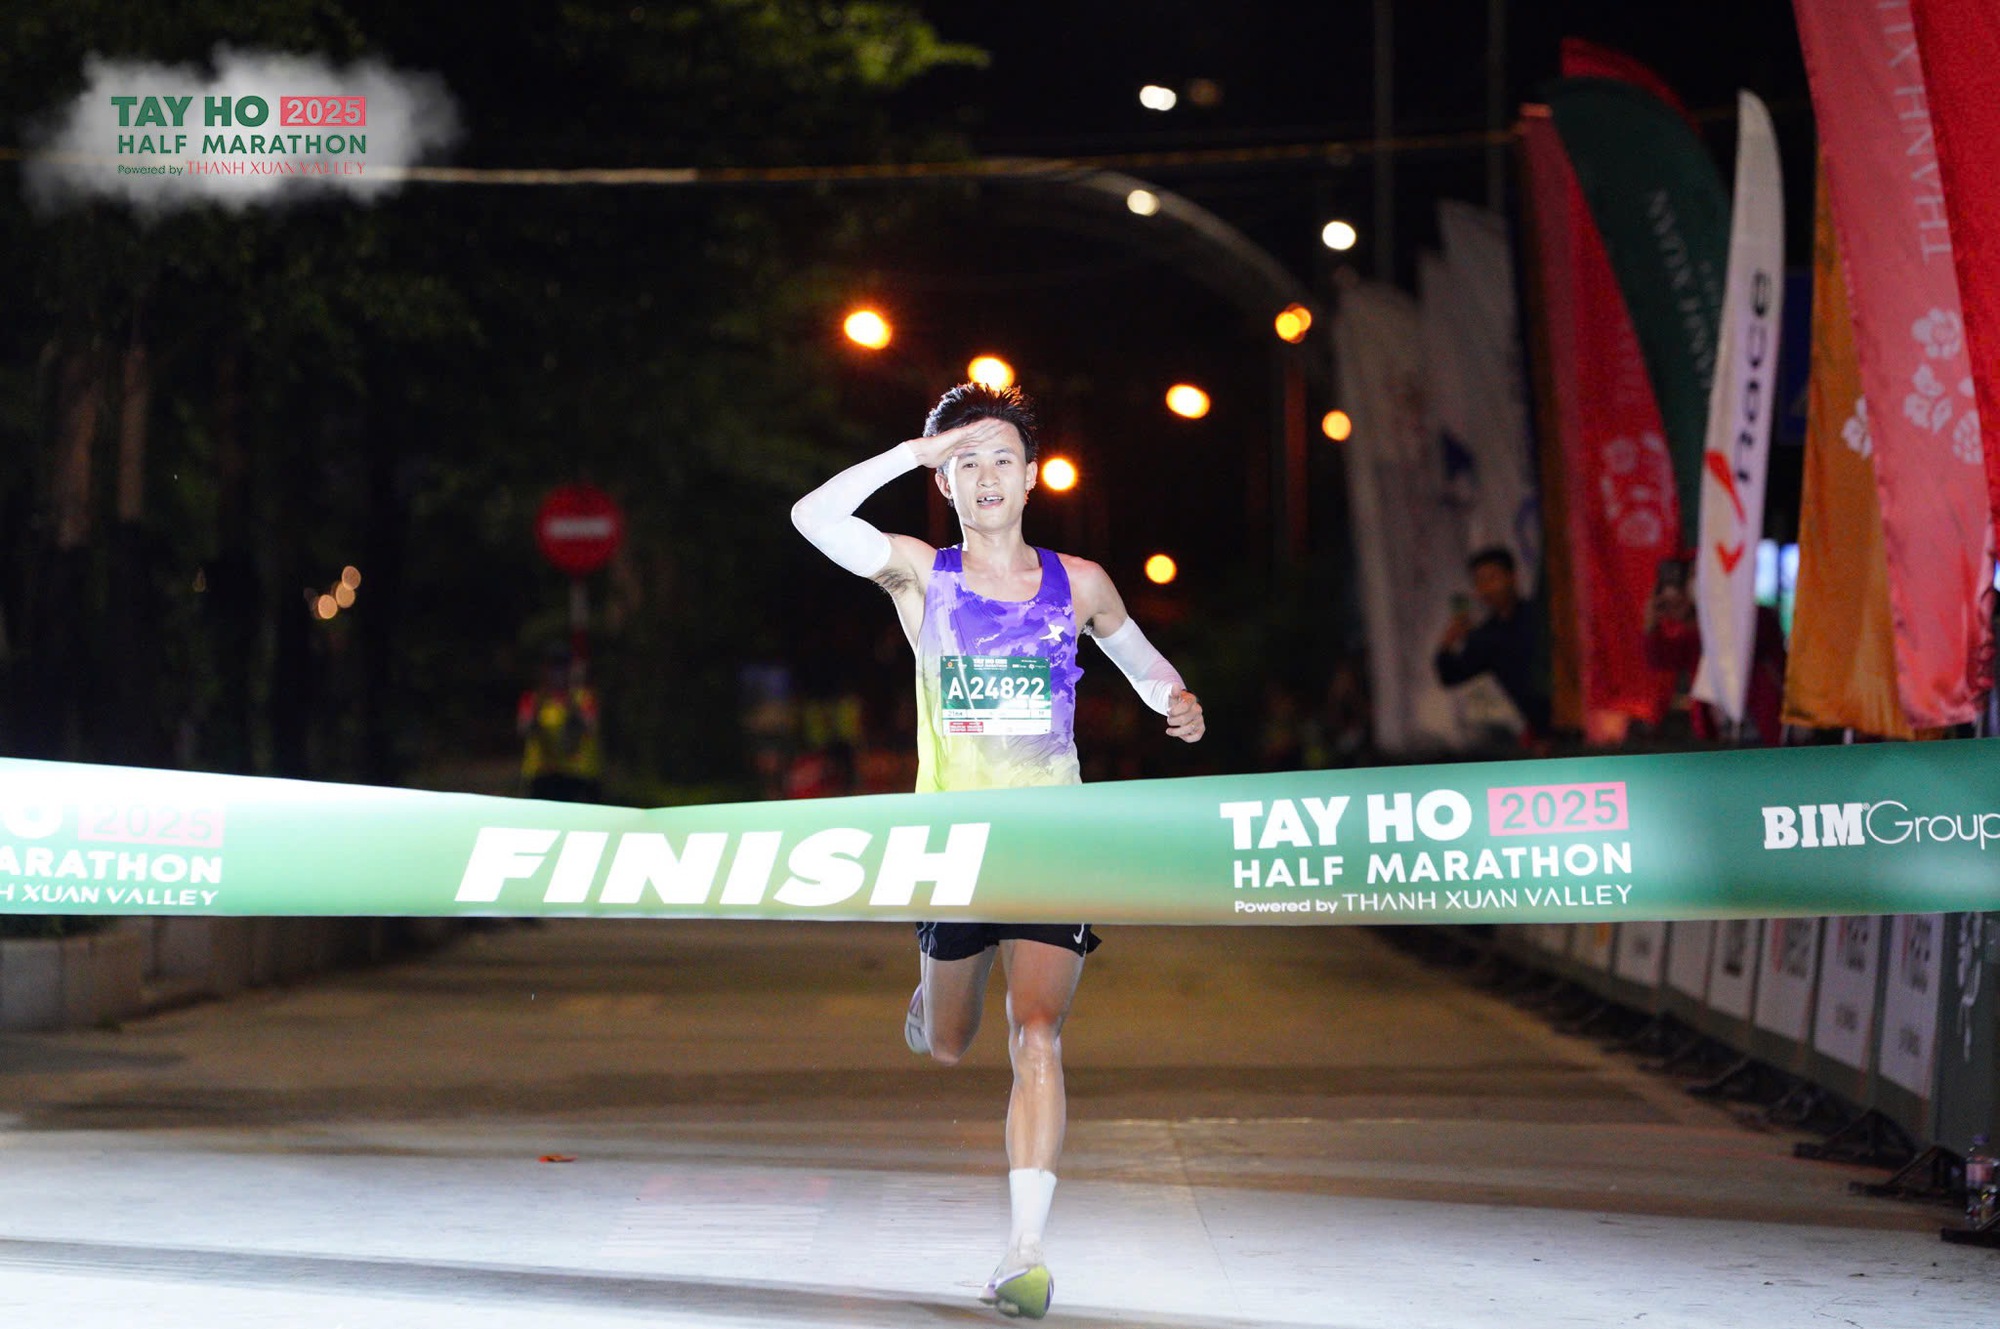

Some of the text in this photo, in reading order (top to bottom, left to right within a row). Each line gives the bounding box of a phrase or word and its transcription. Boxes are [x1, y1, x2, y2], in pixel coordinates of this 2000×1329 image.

[948, 677, 1045, 700] A 24822
[1219, 788, 1619, 850] TAY HO 2025
[454, 822, 991, 907] FINISH
[1233, 842, 1632, 888] HALF MARATHON
[21, 884, 100, 903] XUAN
[106, 887, 219, 906] VALLEY
[1234, 884, 1632, 914] Powered by THANH XUAN VALLEY
